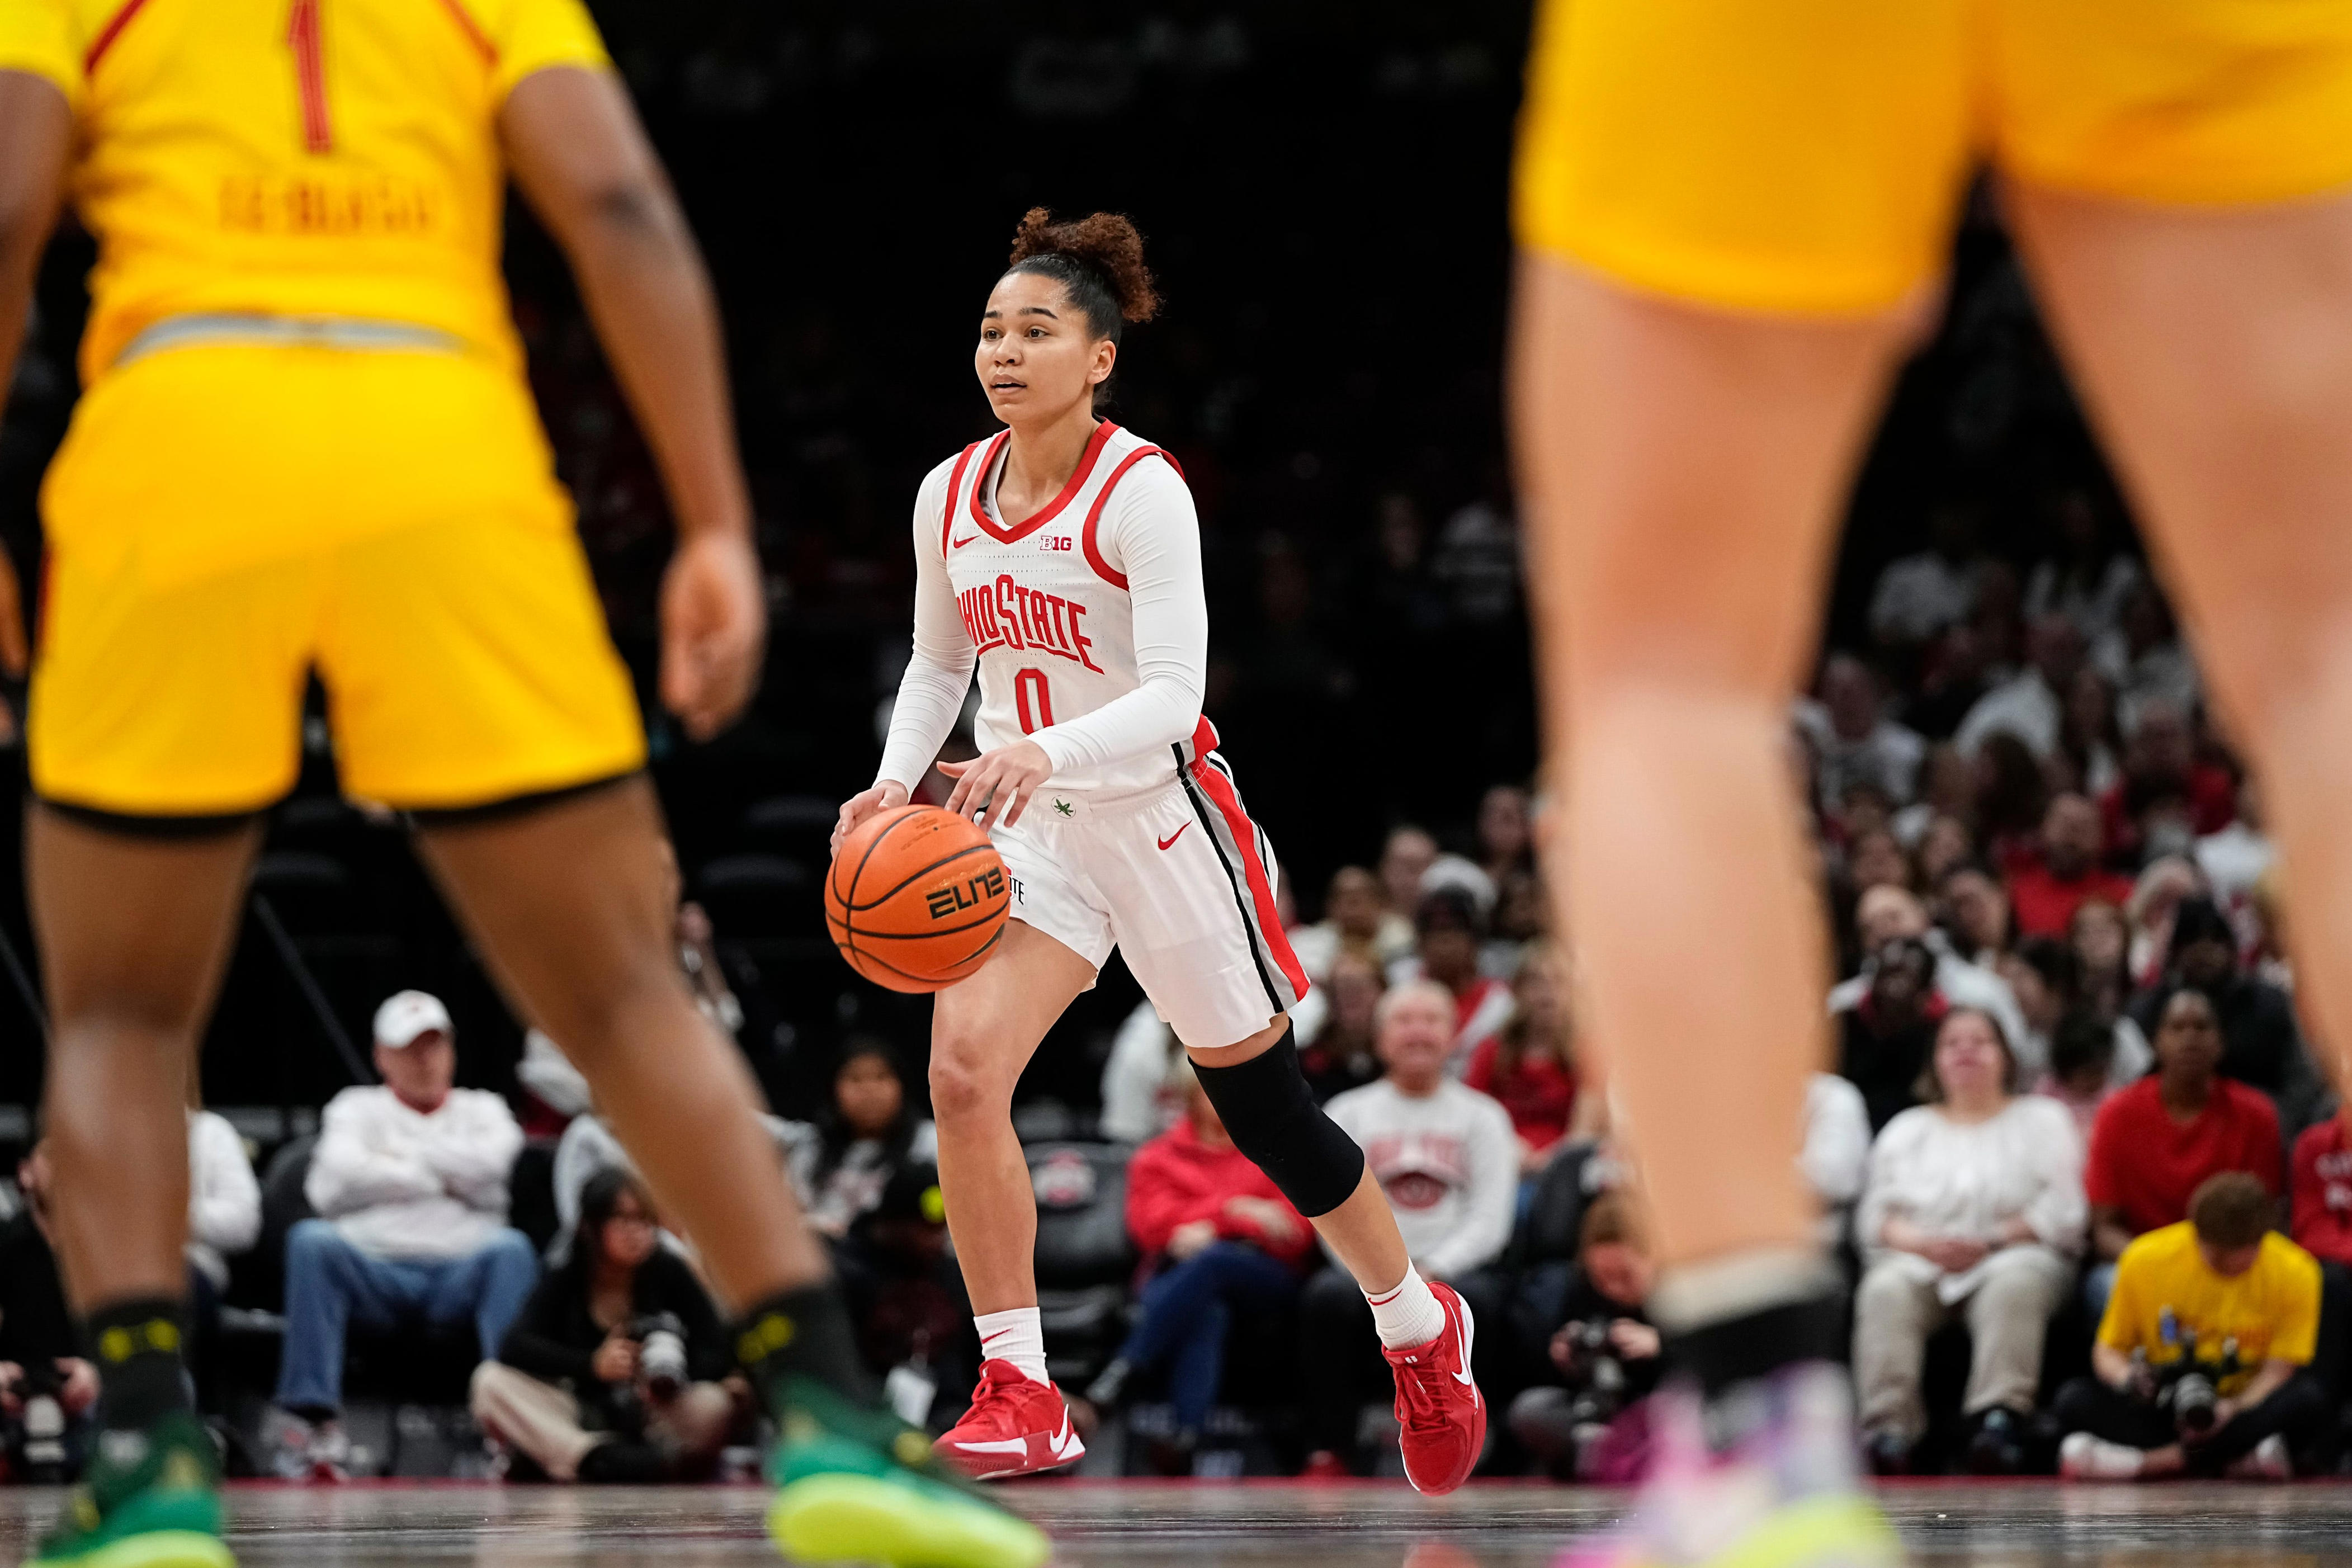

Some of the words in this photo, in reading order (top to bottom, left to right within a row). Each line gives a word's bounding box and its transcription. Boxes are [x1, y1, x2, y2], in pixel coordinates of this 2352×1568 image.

[288, 0, 333, 155] 1
[996, 574, 1105, 675] STATE
[926, 866, 1005, 920] ELITE
